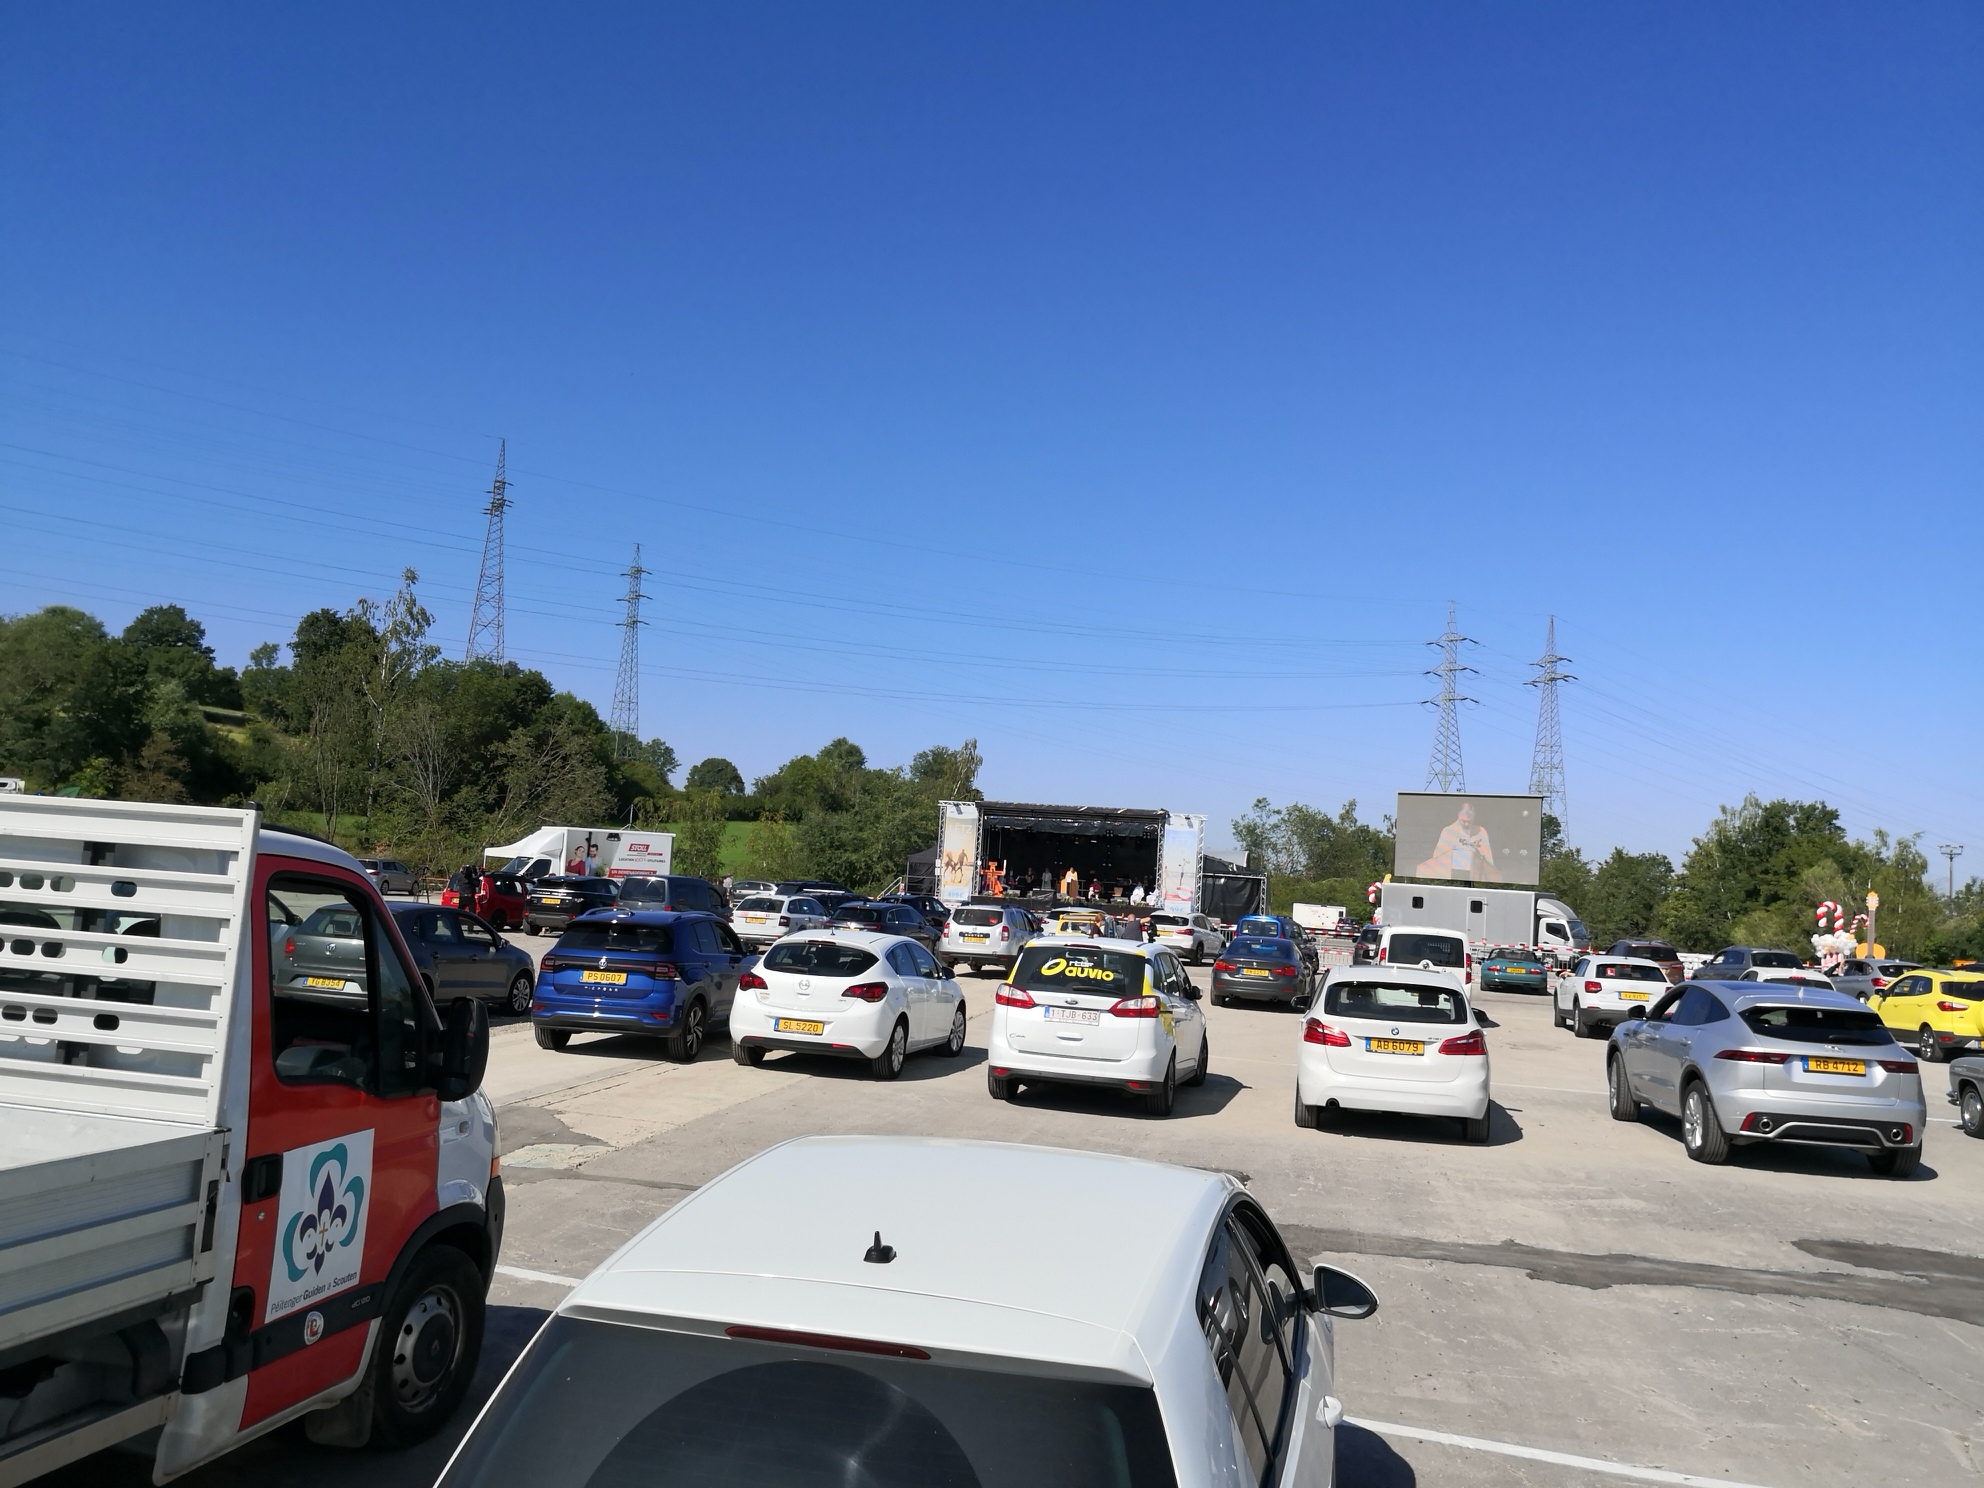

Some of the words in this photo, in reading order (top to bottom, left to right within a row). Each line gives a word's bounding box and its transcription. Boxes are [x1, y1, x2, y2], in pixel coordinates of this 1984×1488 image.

[630, 844, 648, 852] STOLL
[587, 972, 599, 981] PS
[600, 973, 622, 982] 0607
[1064, 966, 1114, 981] auvio
[783, 1021, 794, 1030] SL
[795, 1022, 819, 1033] 5220
[1376, 1040, 1390, 1050] AB
[1391, 1041, 1419, 1052] 6079
[1815, 1060, 1830, 1070] RB
[1832, 1061, 1859, 1072] 4712
[303, 1284, 326, 1300] Guiden
[332, 1271, 358, 1288] Scouten
